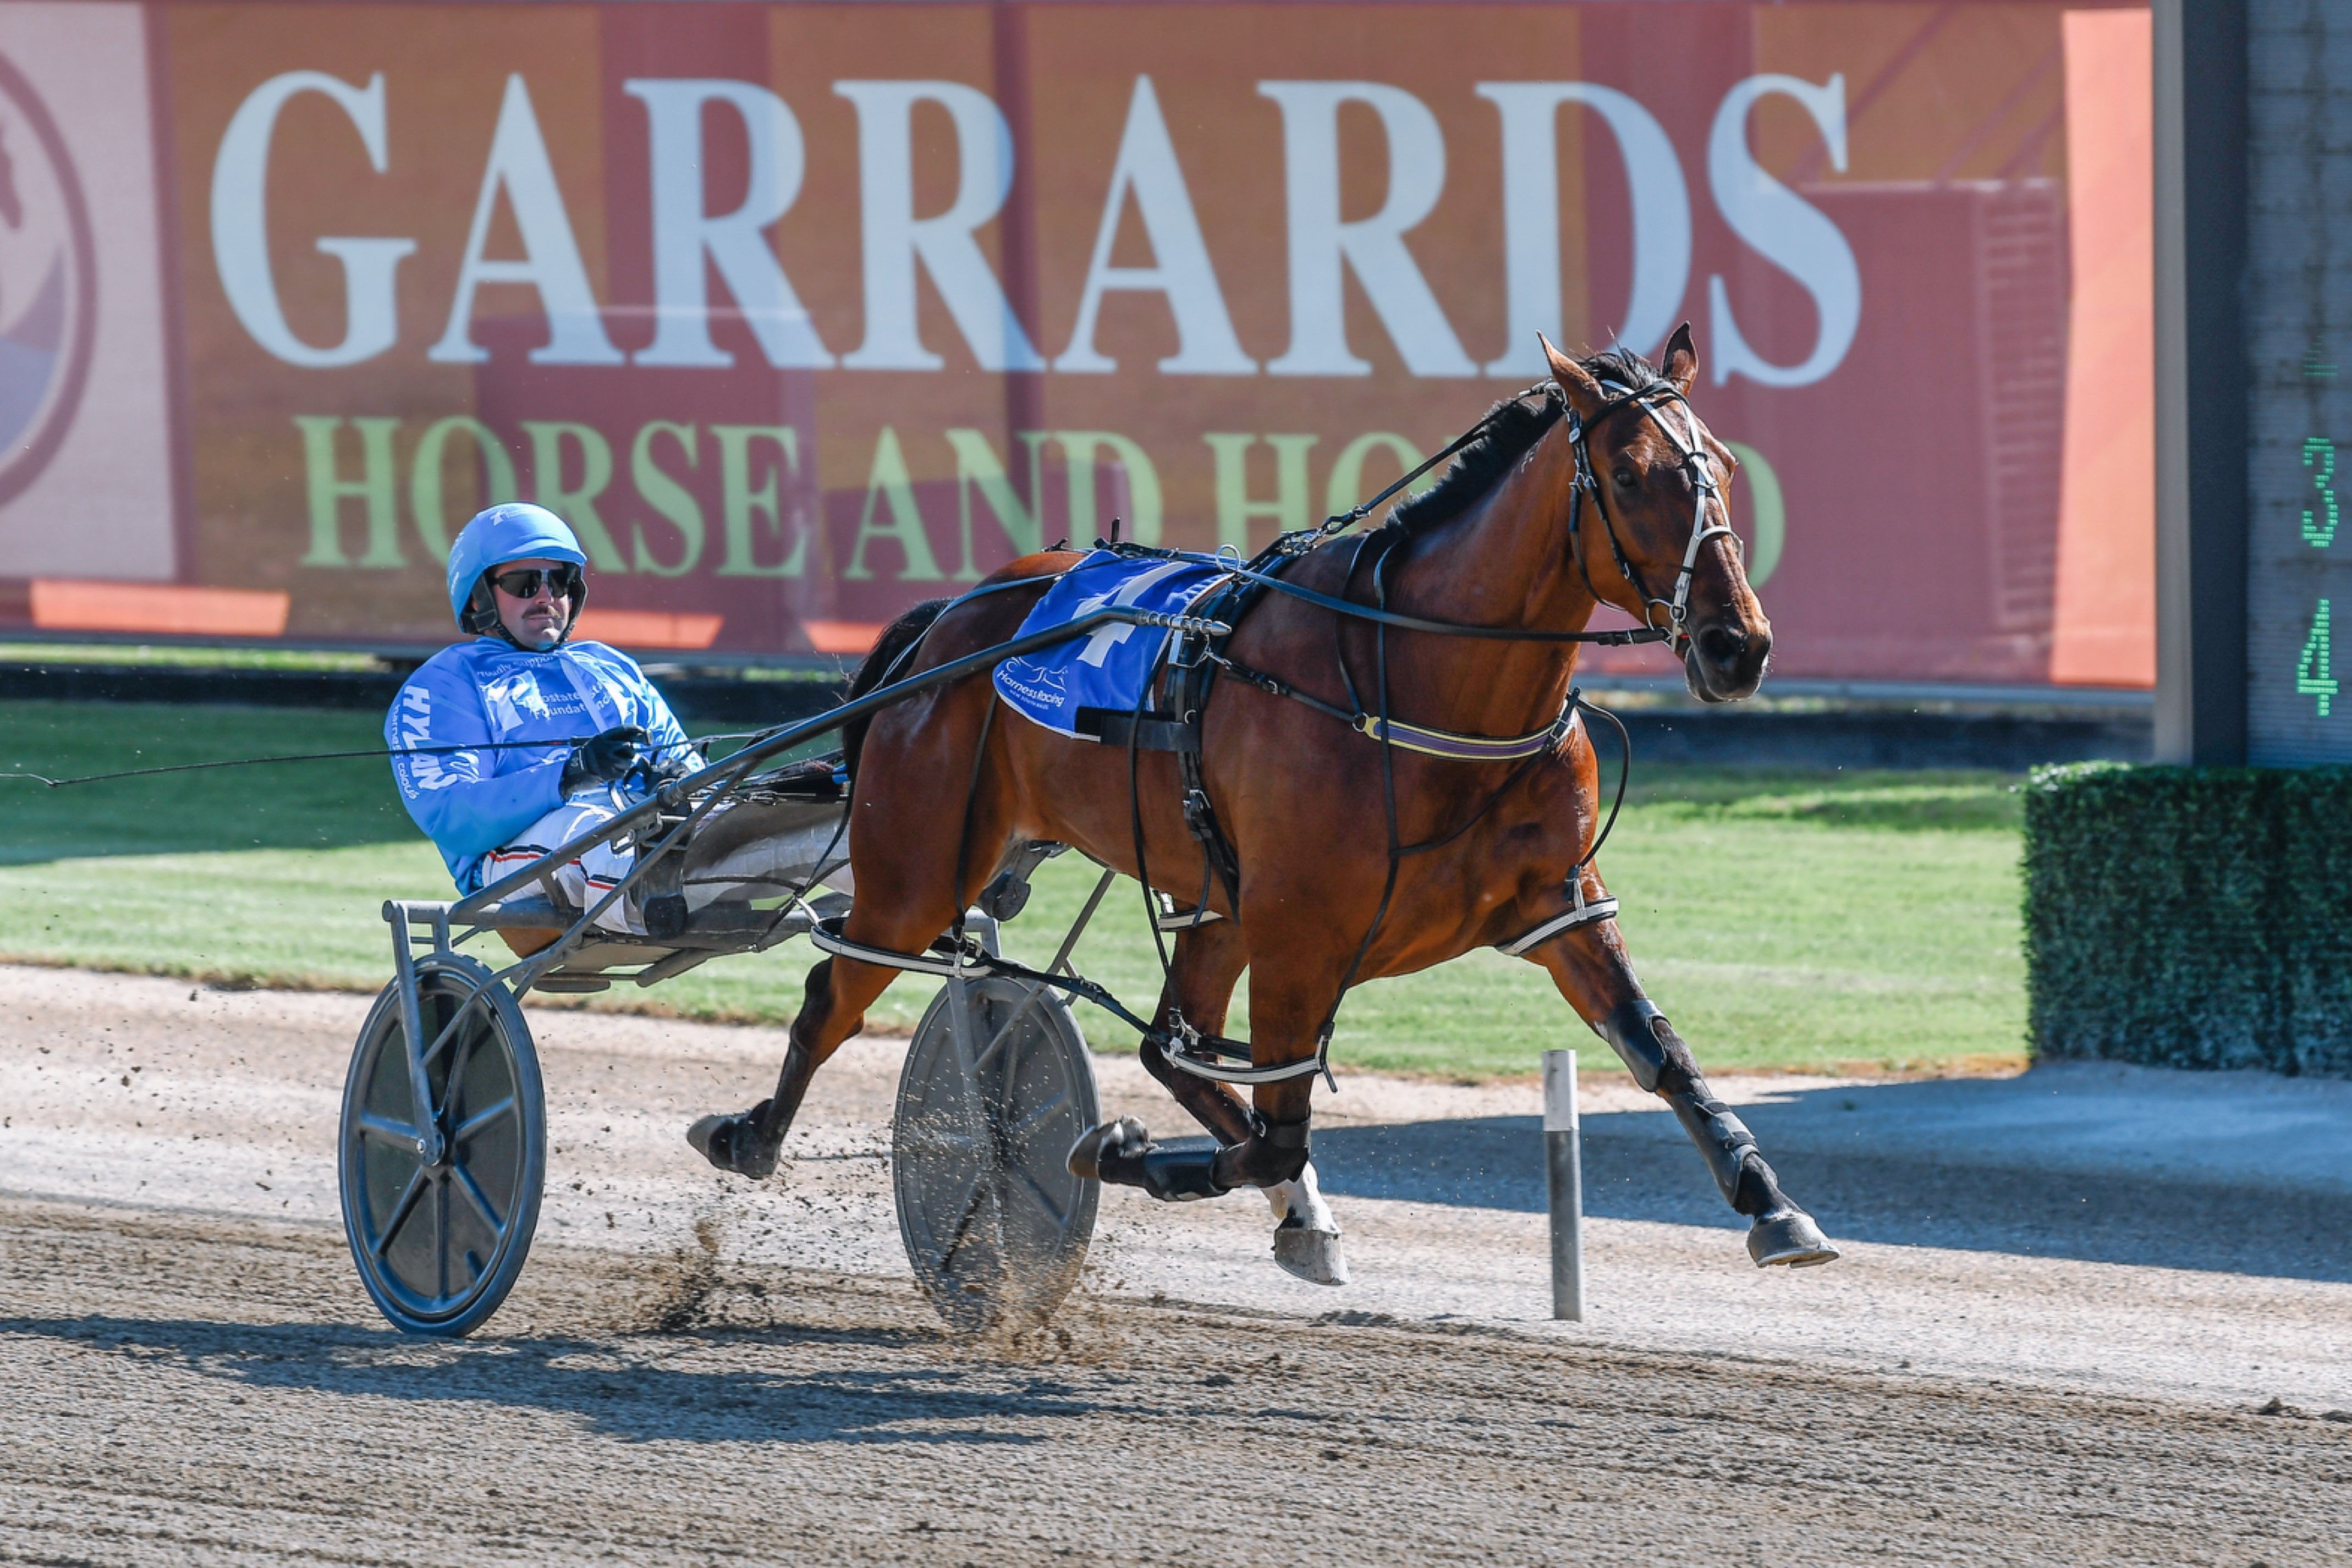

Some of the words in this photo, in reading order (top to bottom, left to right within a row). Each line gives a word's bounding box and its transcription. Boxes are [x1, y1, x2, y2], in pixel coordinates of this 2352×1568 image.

[210, 69, 1861, 389] GARRARDS
[293, 415, 807, 579] HORSE
[843, 426, 1162, 585] AND
[2303, 436, 2337, 548] 3
[2296, 597, 2338, 716] 4
[403, 685, 459, 790] HYLAN
